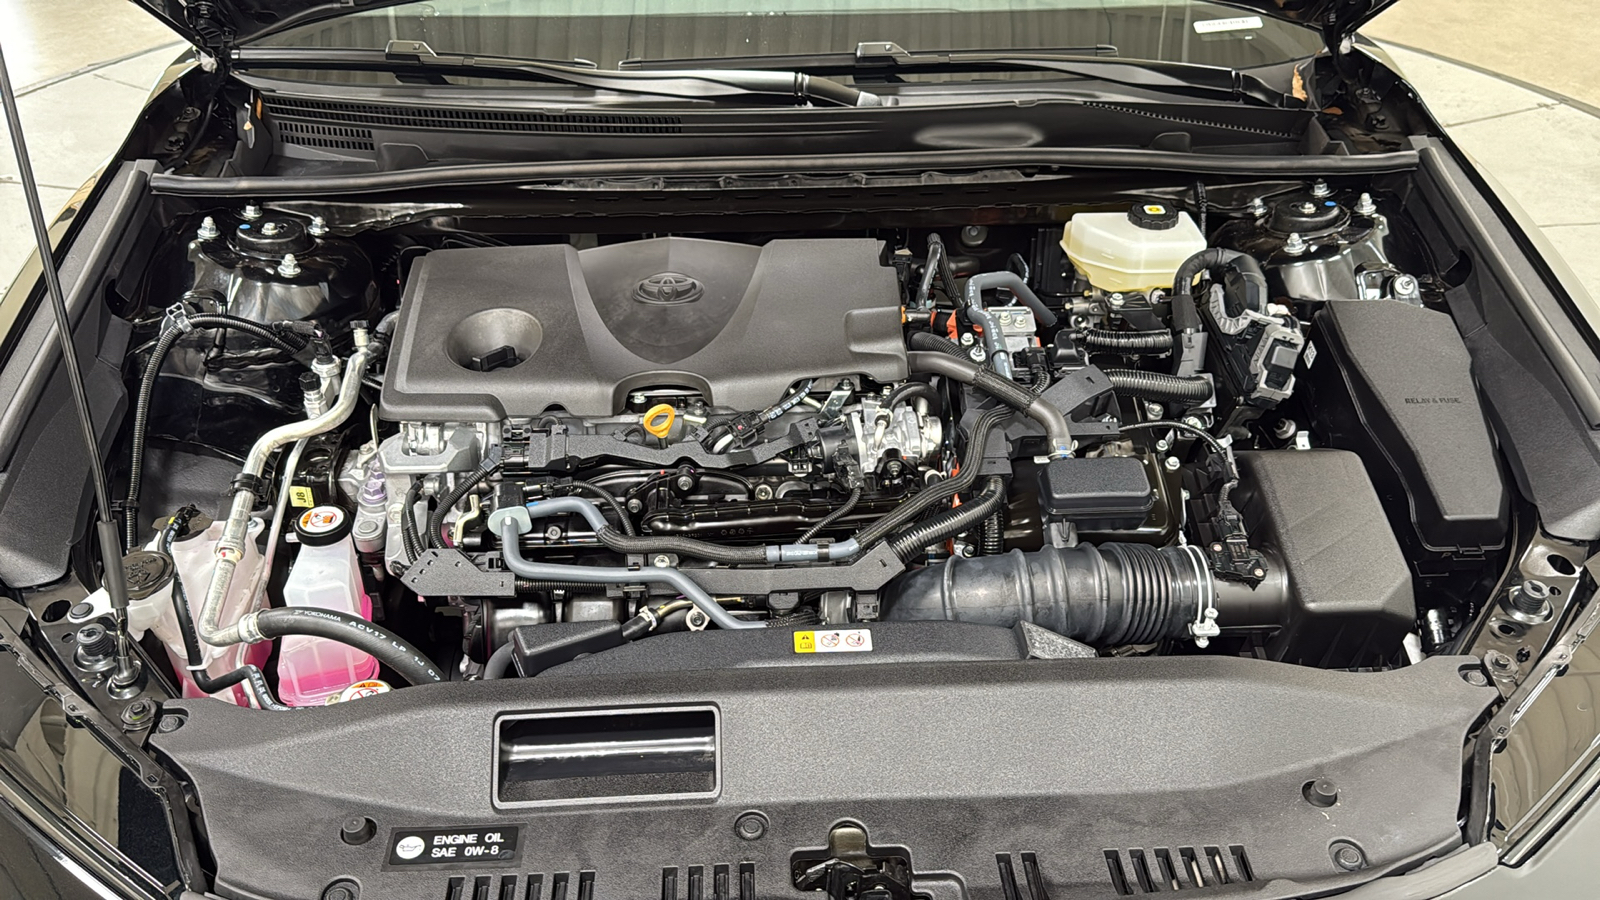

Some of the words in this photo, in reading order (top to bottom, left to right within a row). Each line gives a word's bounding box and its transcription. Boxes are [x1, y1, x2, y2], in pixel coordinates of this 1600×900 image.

[304, 610, 341, 622] YOKOHAMA
[349, 621, 387, 640] ACV17
[392, 640, 407, 652] LP
[433, 834, 478, 845] ENGINE
[484, 833, 505, 843] OIL
[431, 847, 457, 858] SAE
[464, 845, 500, 857] 0W-8
